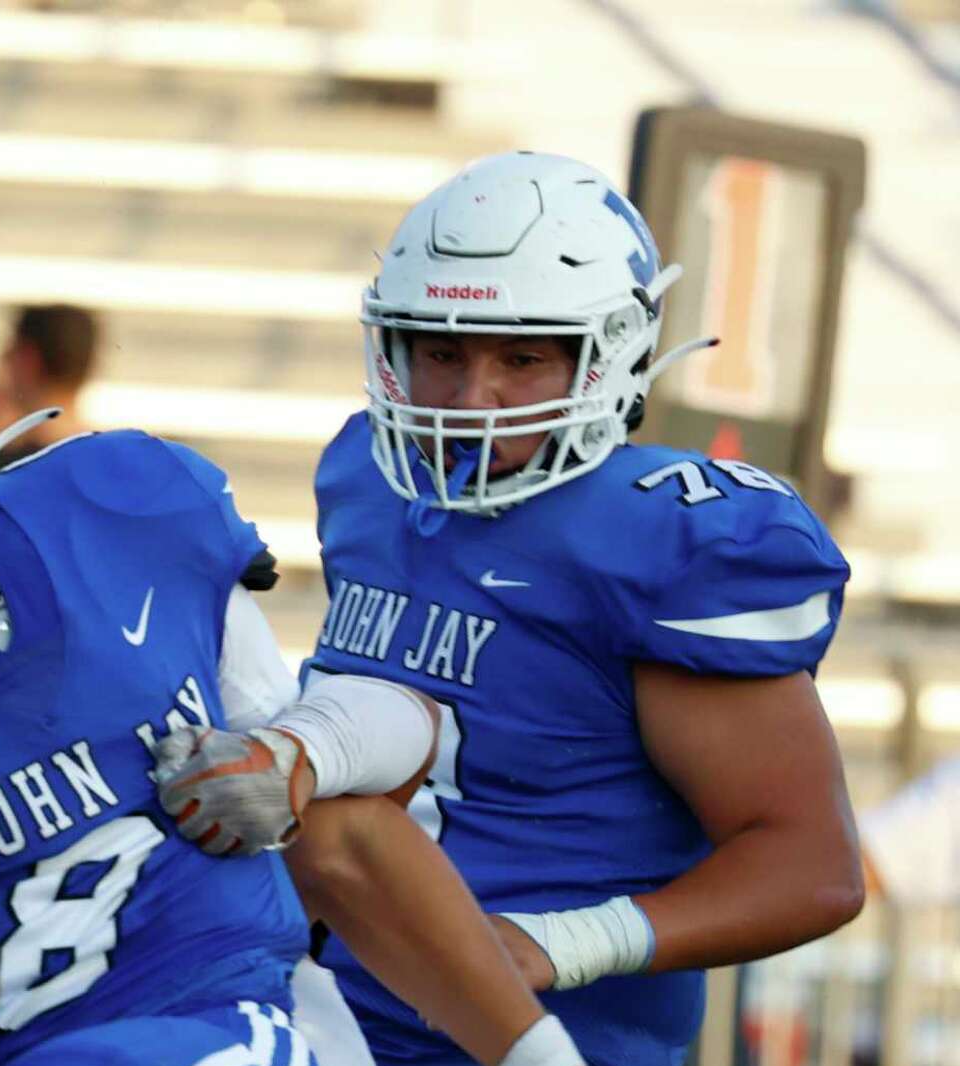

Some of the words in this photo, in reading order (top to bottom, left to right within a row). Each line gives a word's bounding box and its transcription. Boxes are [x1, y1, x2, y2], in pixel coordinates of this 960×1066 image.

[425, 283, 498, 300] Riddell
[321, 579, 410, 660] JOHN
[403, 603, 497, 687] JAY
